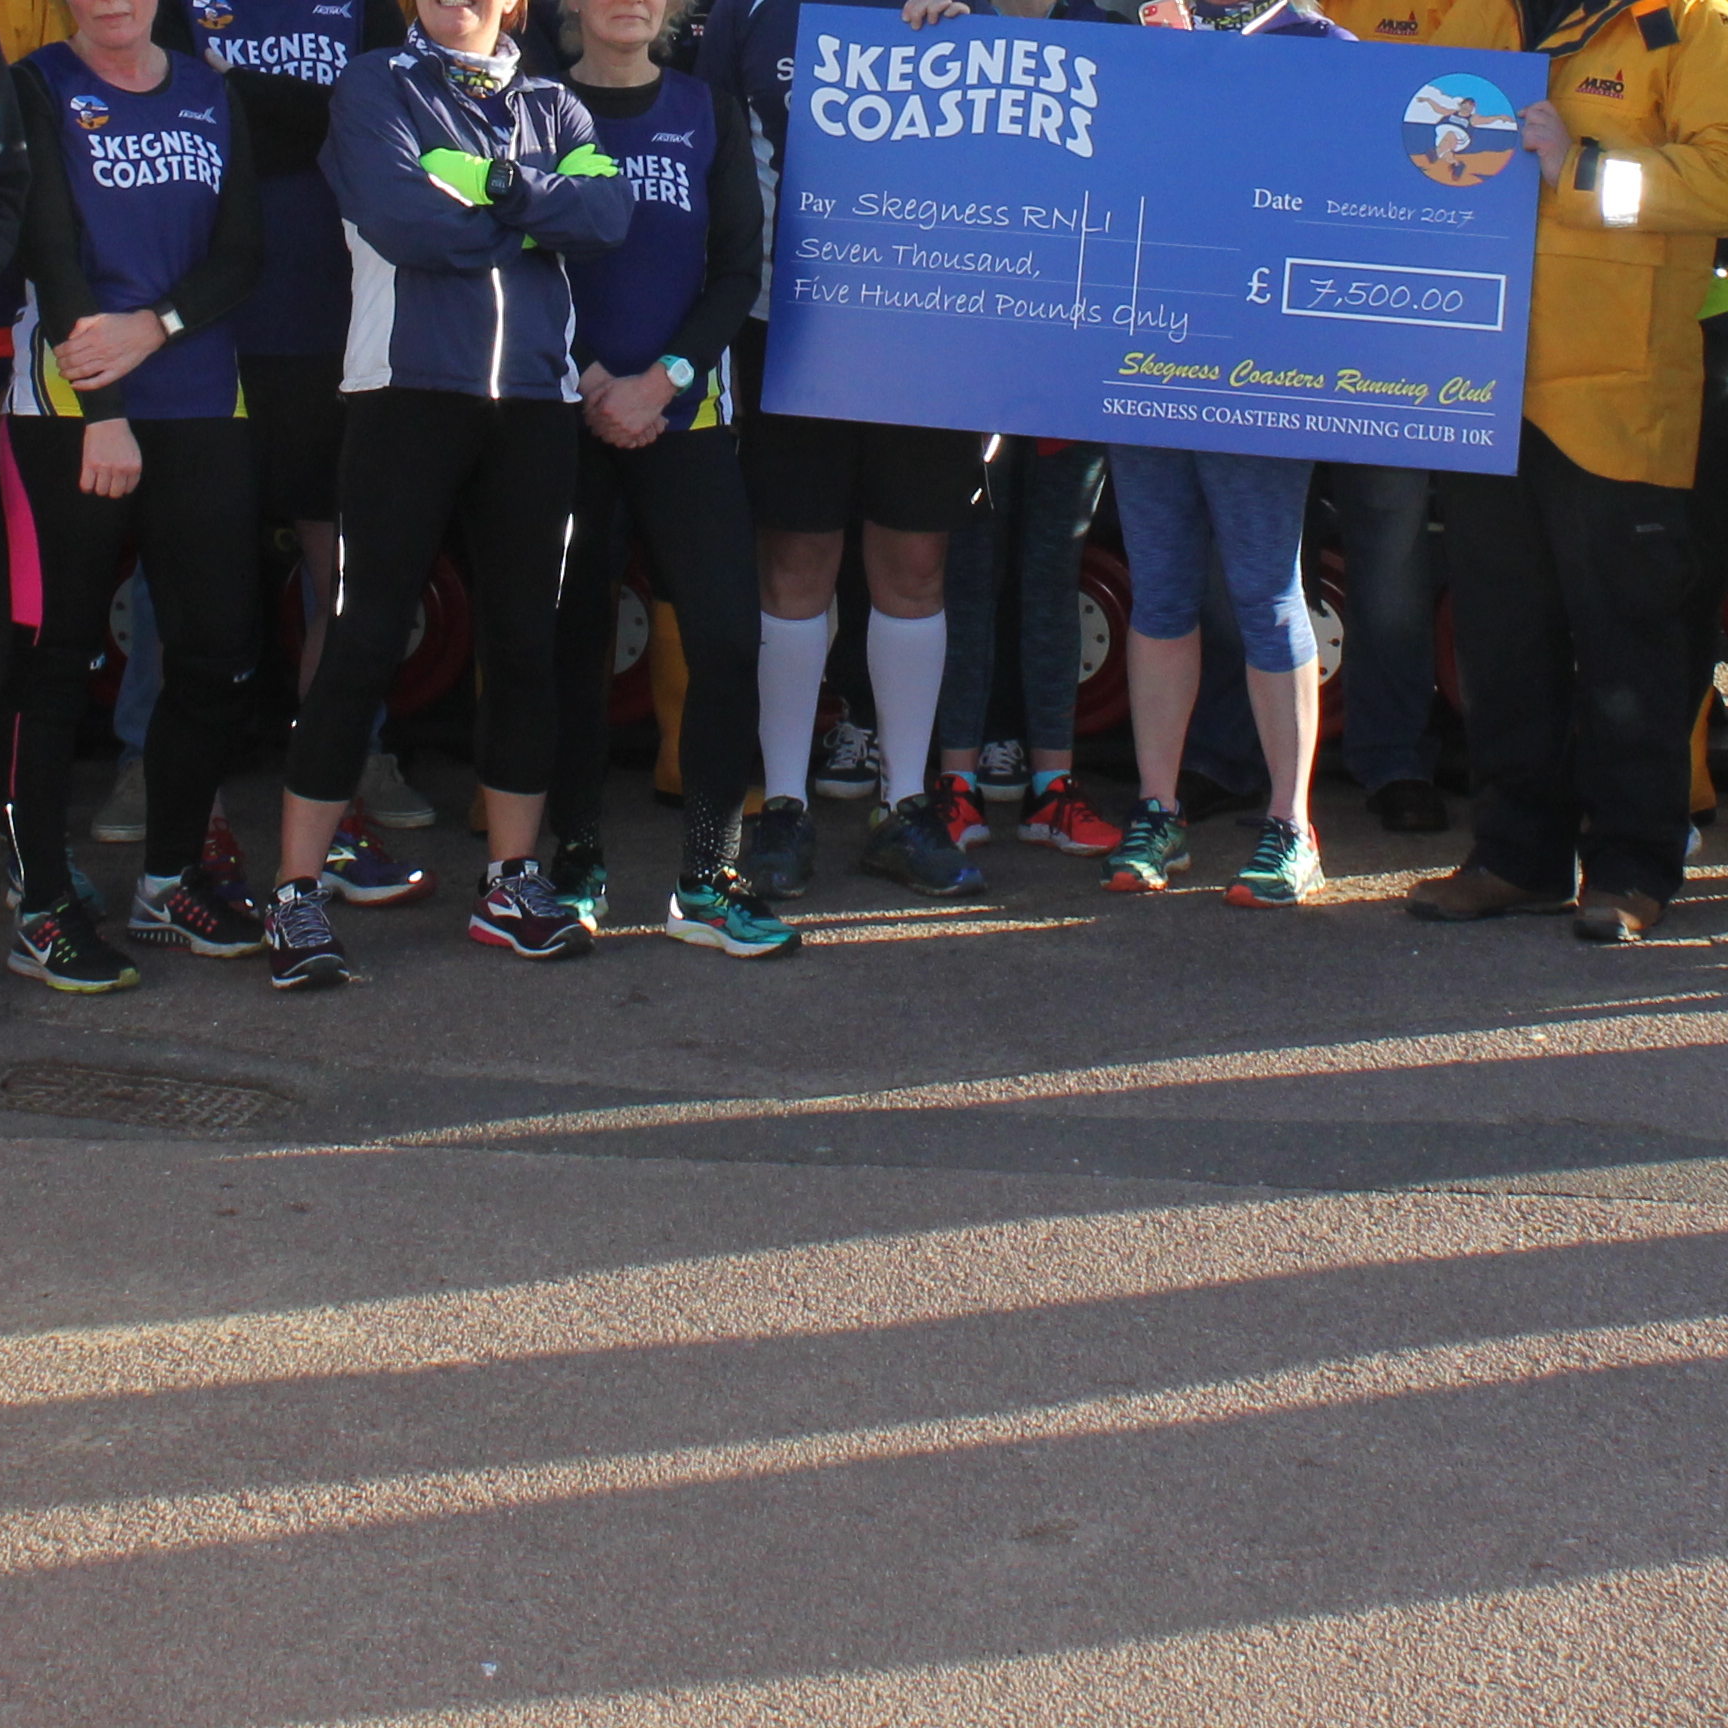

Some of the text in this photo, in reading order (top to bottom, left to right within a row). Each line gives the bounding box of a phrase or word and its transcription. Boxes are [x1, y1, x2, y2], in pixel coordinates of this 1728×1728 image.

[208, 33, 348, 69] SKEGNESS
[813, 34, 1098, 108] SKEGNESS
[810, 87, 1094, 158] COASTERS
[88, 131, 223, 167] SKEGNESS
[92, 155, 222, 194] COASTERS
[800, 189, 1112, 233] Pay Skegness RNLI
[1252, 188, 1475, 229] Date December 2017
[796, 238, 1041, 279] Seven Thousand,
[794, 276, 1189, 343] Five Hundred Pounds Only
[1246, 267, 1463, 314] £ 7,500.00
[1118, 352, 1496, 405] Skegness Coasters Running Club
[1102, 397, 1496, 447] SKEGNESS COASTERS RUNNING CLUB 10K
